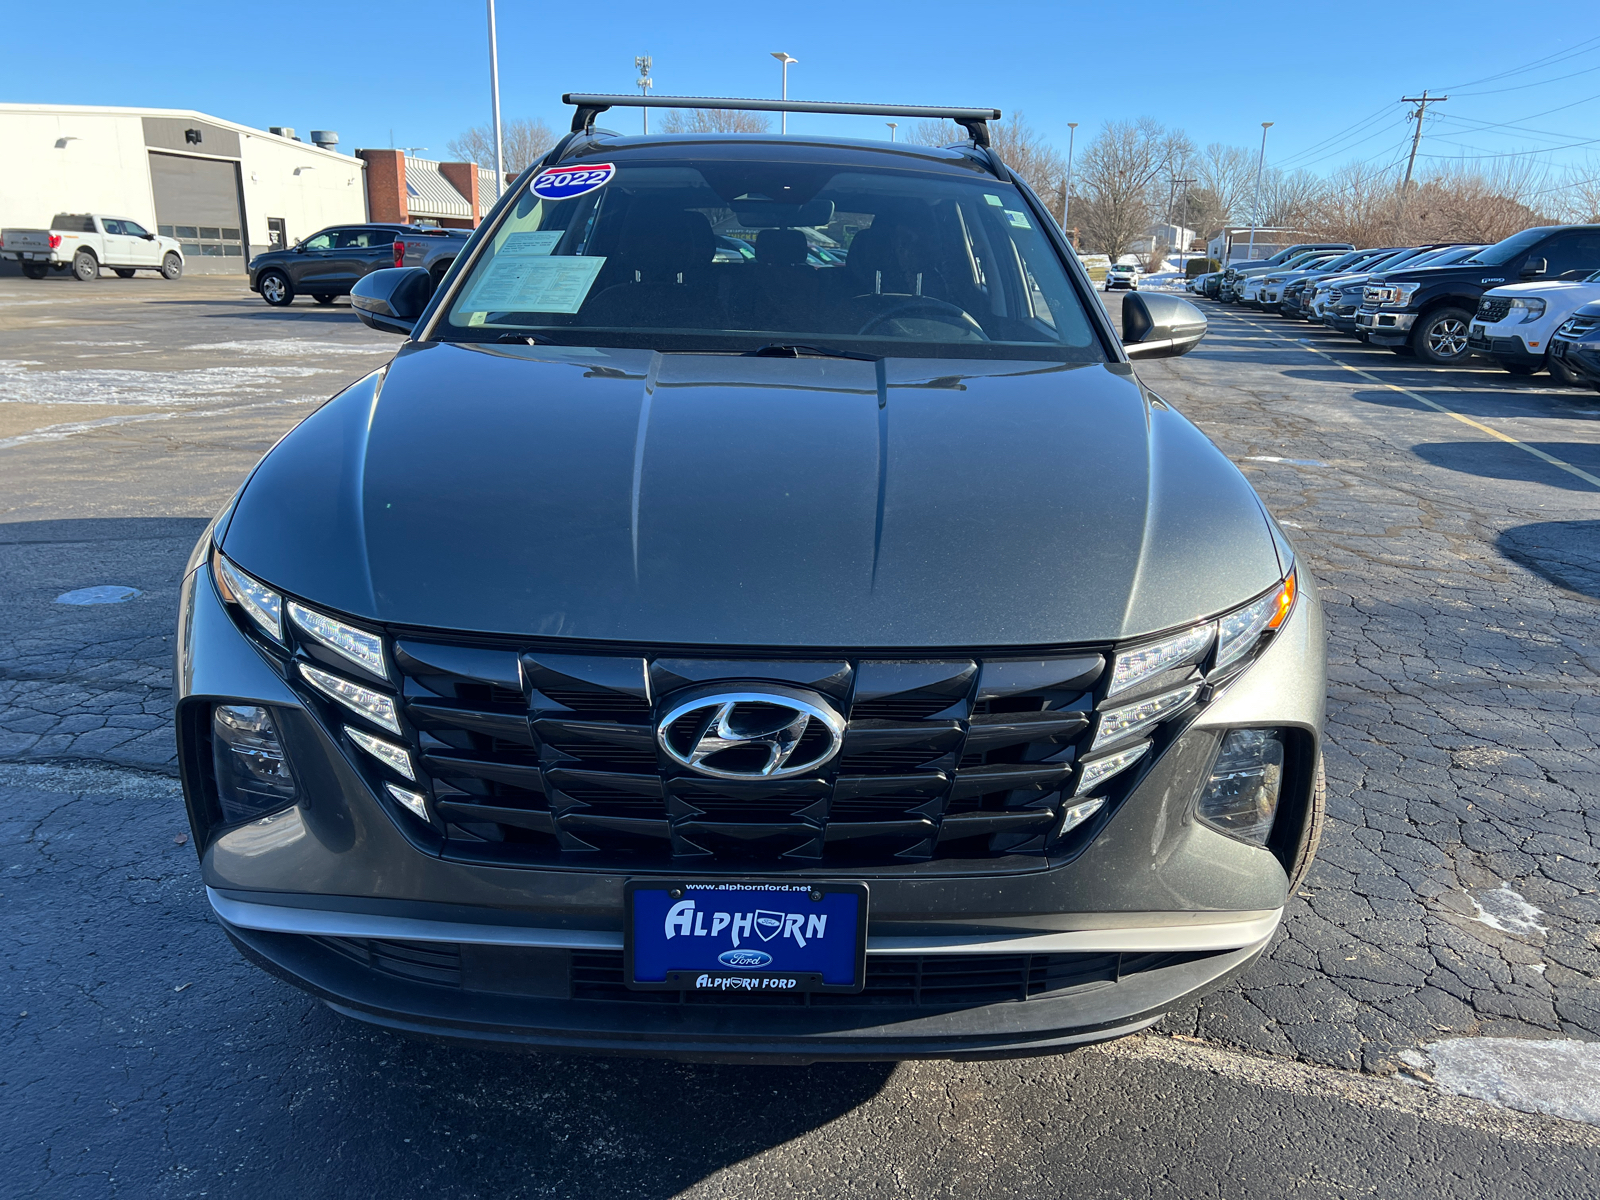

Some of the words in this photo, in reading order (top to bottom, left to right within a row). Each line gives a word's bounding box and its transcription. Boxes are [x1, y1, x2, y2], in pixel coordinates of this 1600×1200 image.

[535, 171, 607, 189] 2022
[685, 883, 812, 892] www.alphornford.net
[729, 953, 761, 965] Ford
[762, 978, 797, 989] FORD
